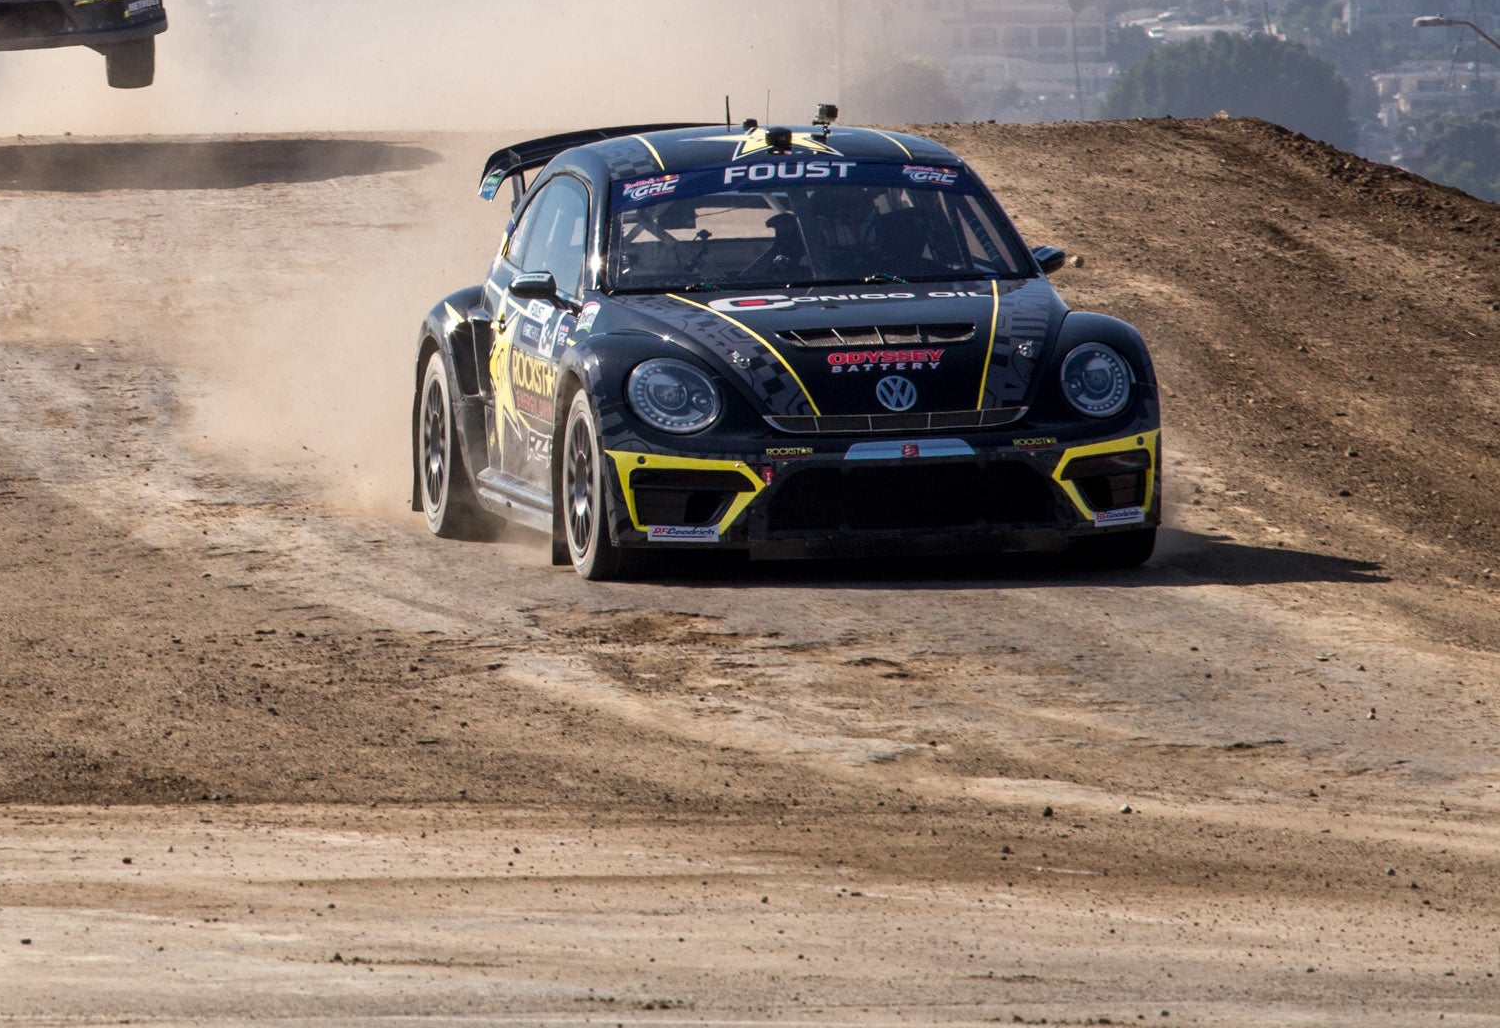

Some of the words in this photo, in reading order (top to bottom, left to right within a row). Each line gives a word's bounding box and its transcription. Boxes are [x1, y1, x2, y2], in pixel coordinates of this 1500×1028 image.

[723, 160, 857, 184] FOUST
[911, 170, 958, 184] GRC
[632, 178, 681, 200] GRC
[707, 292, 917, 313] CONICO
[927, 290, 993, 299] OIL
[827, 348, 945, 366] ODYSSEY
[831, 361, 941, 374] BATTERY
